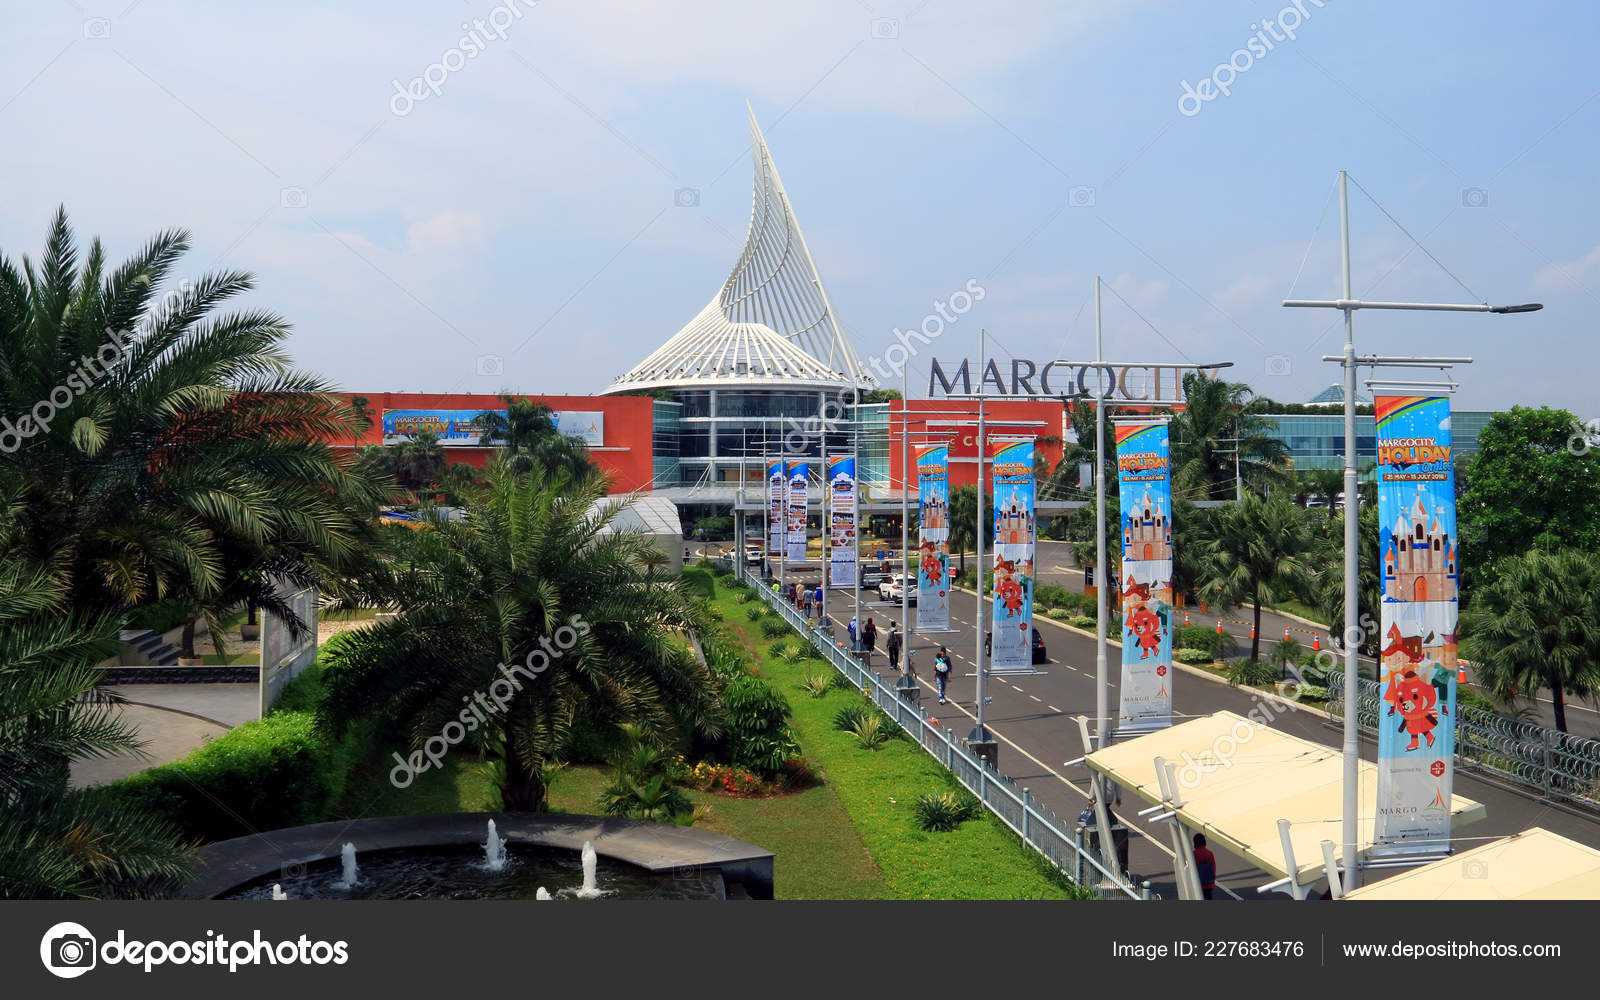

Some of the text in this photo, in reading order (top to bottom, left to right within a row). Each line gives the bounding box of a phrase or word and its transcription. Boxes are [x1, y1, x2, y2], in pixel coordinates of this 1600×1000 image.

[395, 416, 441, 424] MARGOCITY
[395, 422, 450, 434] HOLIDAY
[1378, 437, 1435, 447] MARGOCITY
[1378, 445, 1452, 465] HOLIDAY
[1119, 457, 1168, 471] HOLIDAY
[1380, 806, 1418, 816] MARGO
